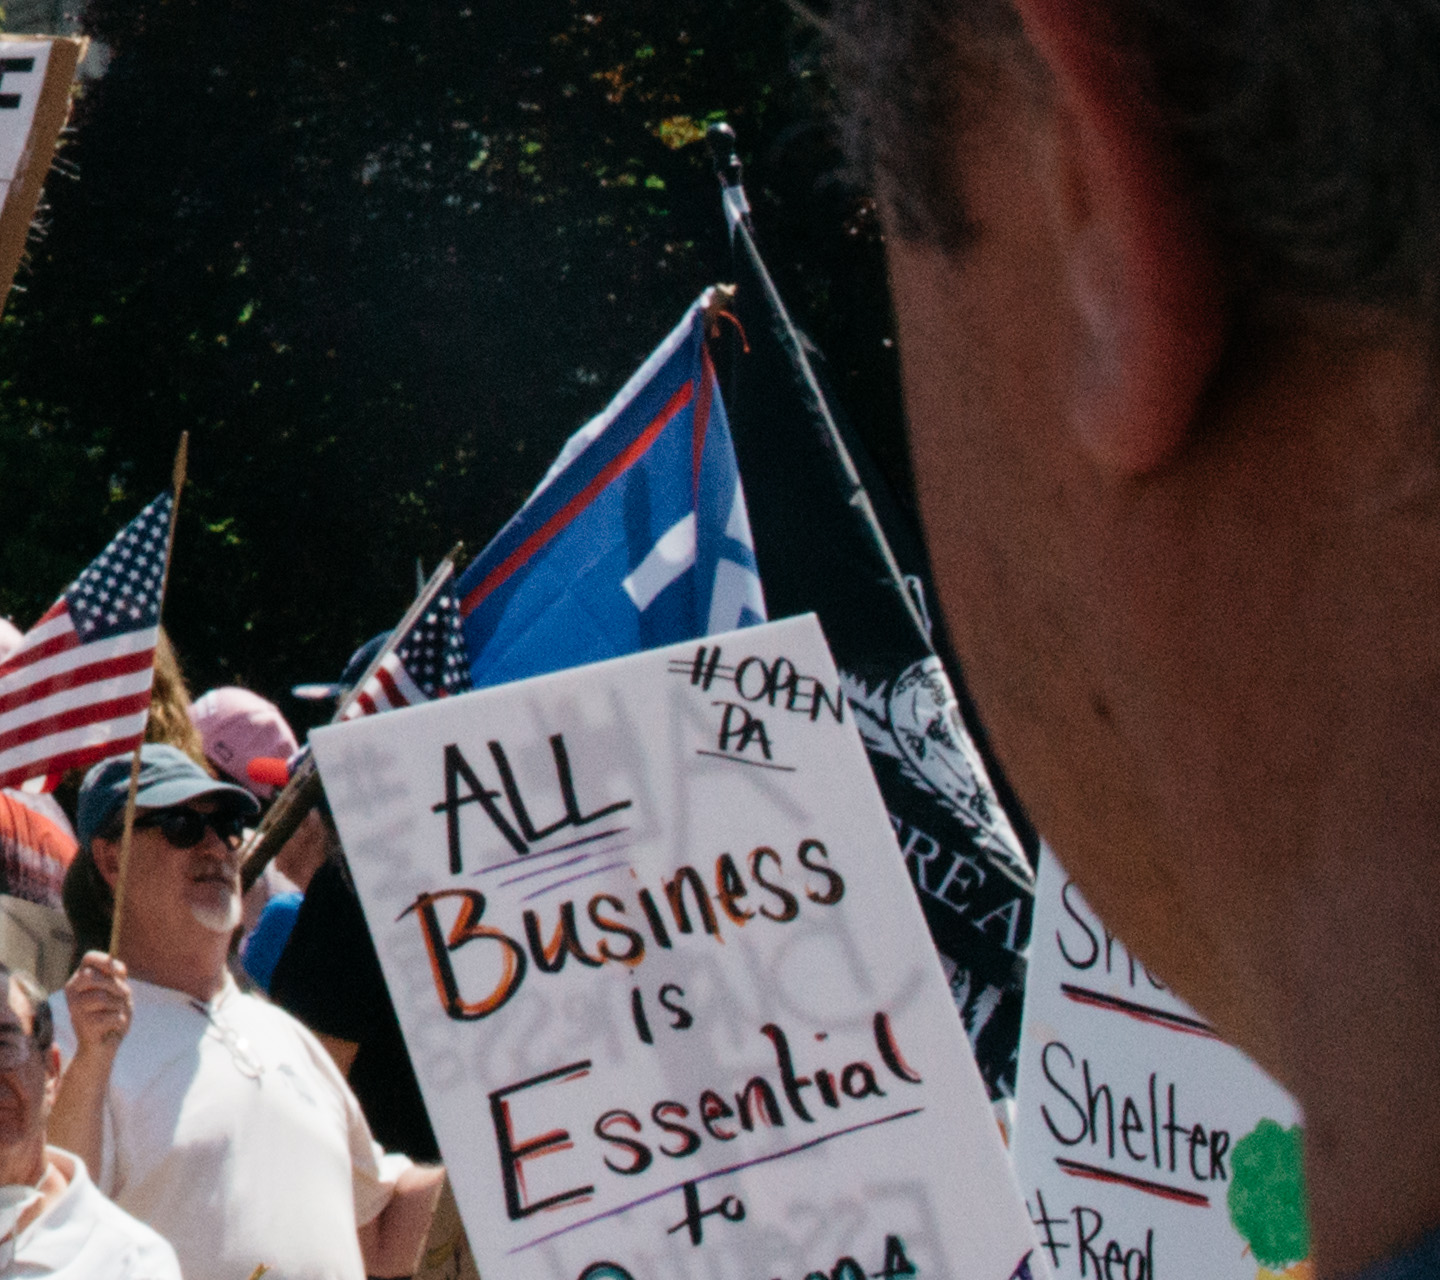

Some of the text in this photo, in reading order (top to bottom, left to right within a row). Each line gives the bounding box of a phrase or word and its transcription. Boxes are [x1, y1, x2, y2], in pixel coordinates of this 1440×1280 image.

[667, 645, 844, 724] #OPEN
[711, 701, 772, 760] PA
[431, 733, 633, 875] ALL
[395, 838, 846, 1021] Business
[488, 1012, 923, 1221] Essential
[667, 1182, 746, 1246] to
